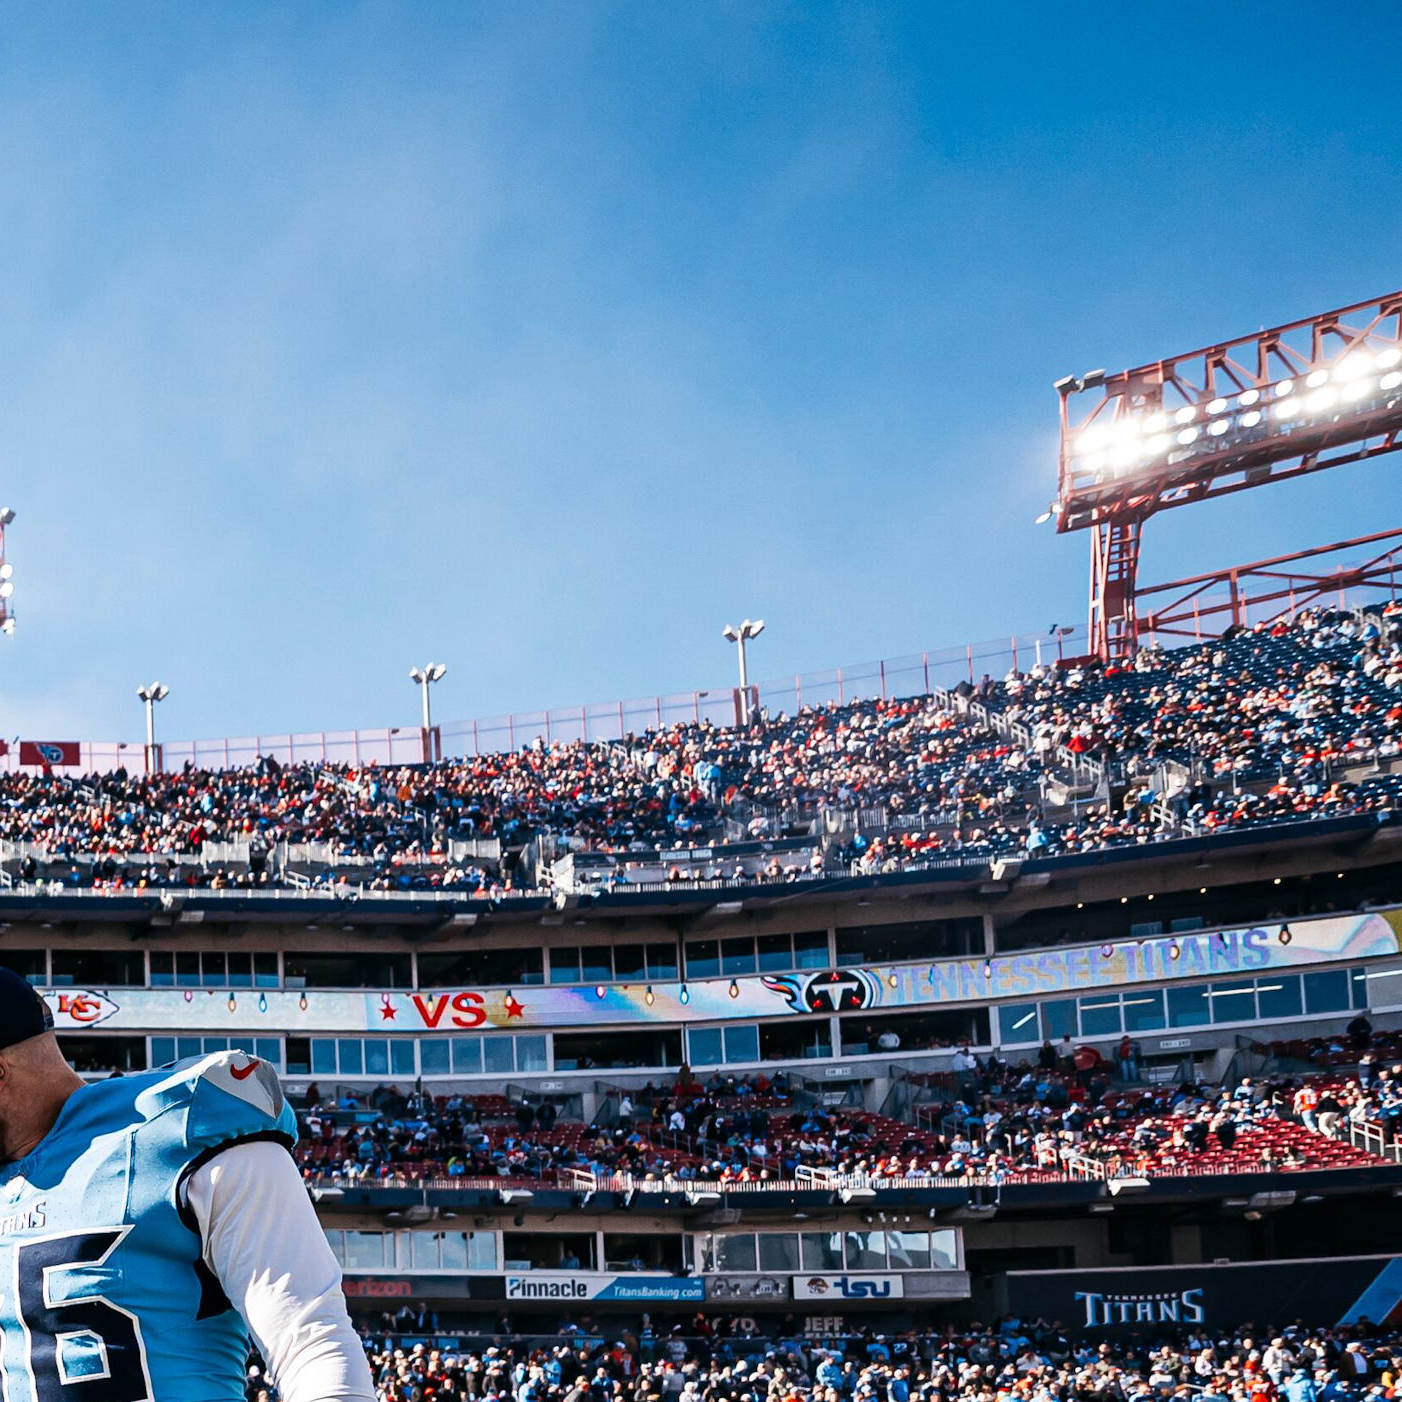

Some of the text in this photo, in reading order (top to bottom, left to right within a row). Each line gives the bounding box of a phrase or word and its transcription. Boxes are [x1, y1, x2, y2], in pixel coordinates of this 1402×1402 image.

[886, 929, 1271, 1005] TENNESSEE TITANS
[412, 991, 487, 1029] VS
[344, 1278, 412, 1297] erizon
[509, 1278, 588, 1300] Pinnacle
[834, 1276, 890, 1298] tsu
[804, 1317, 844, 1332] JEFF
